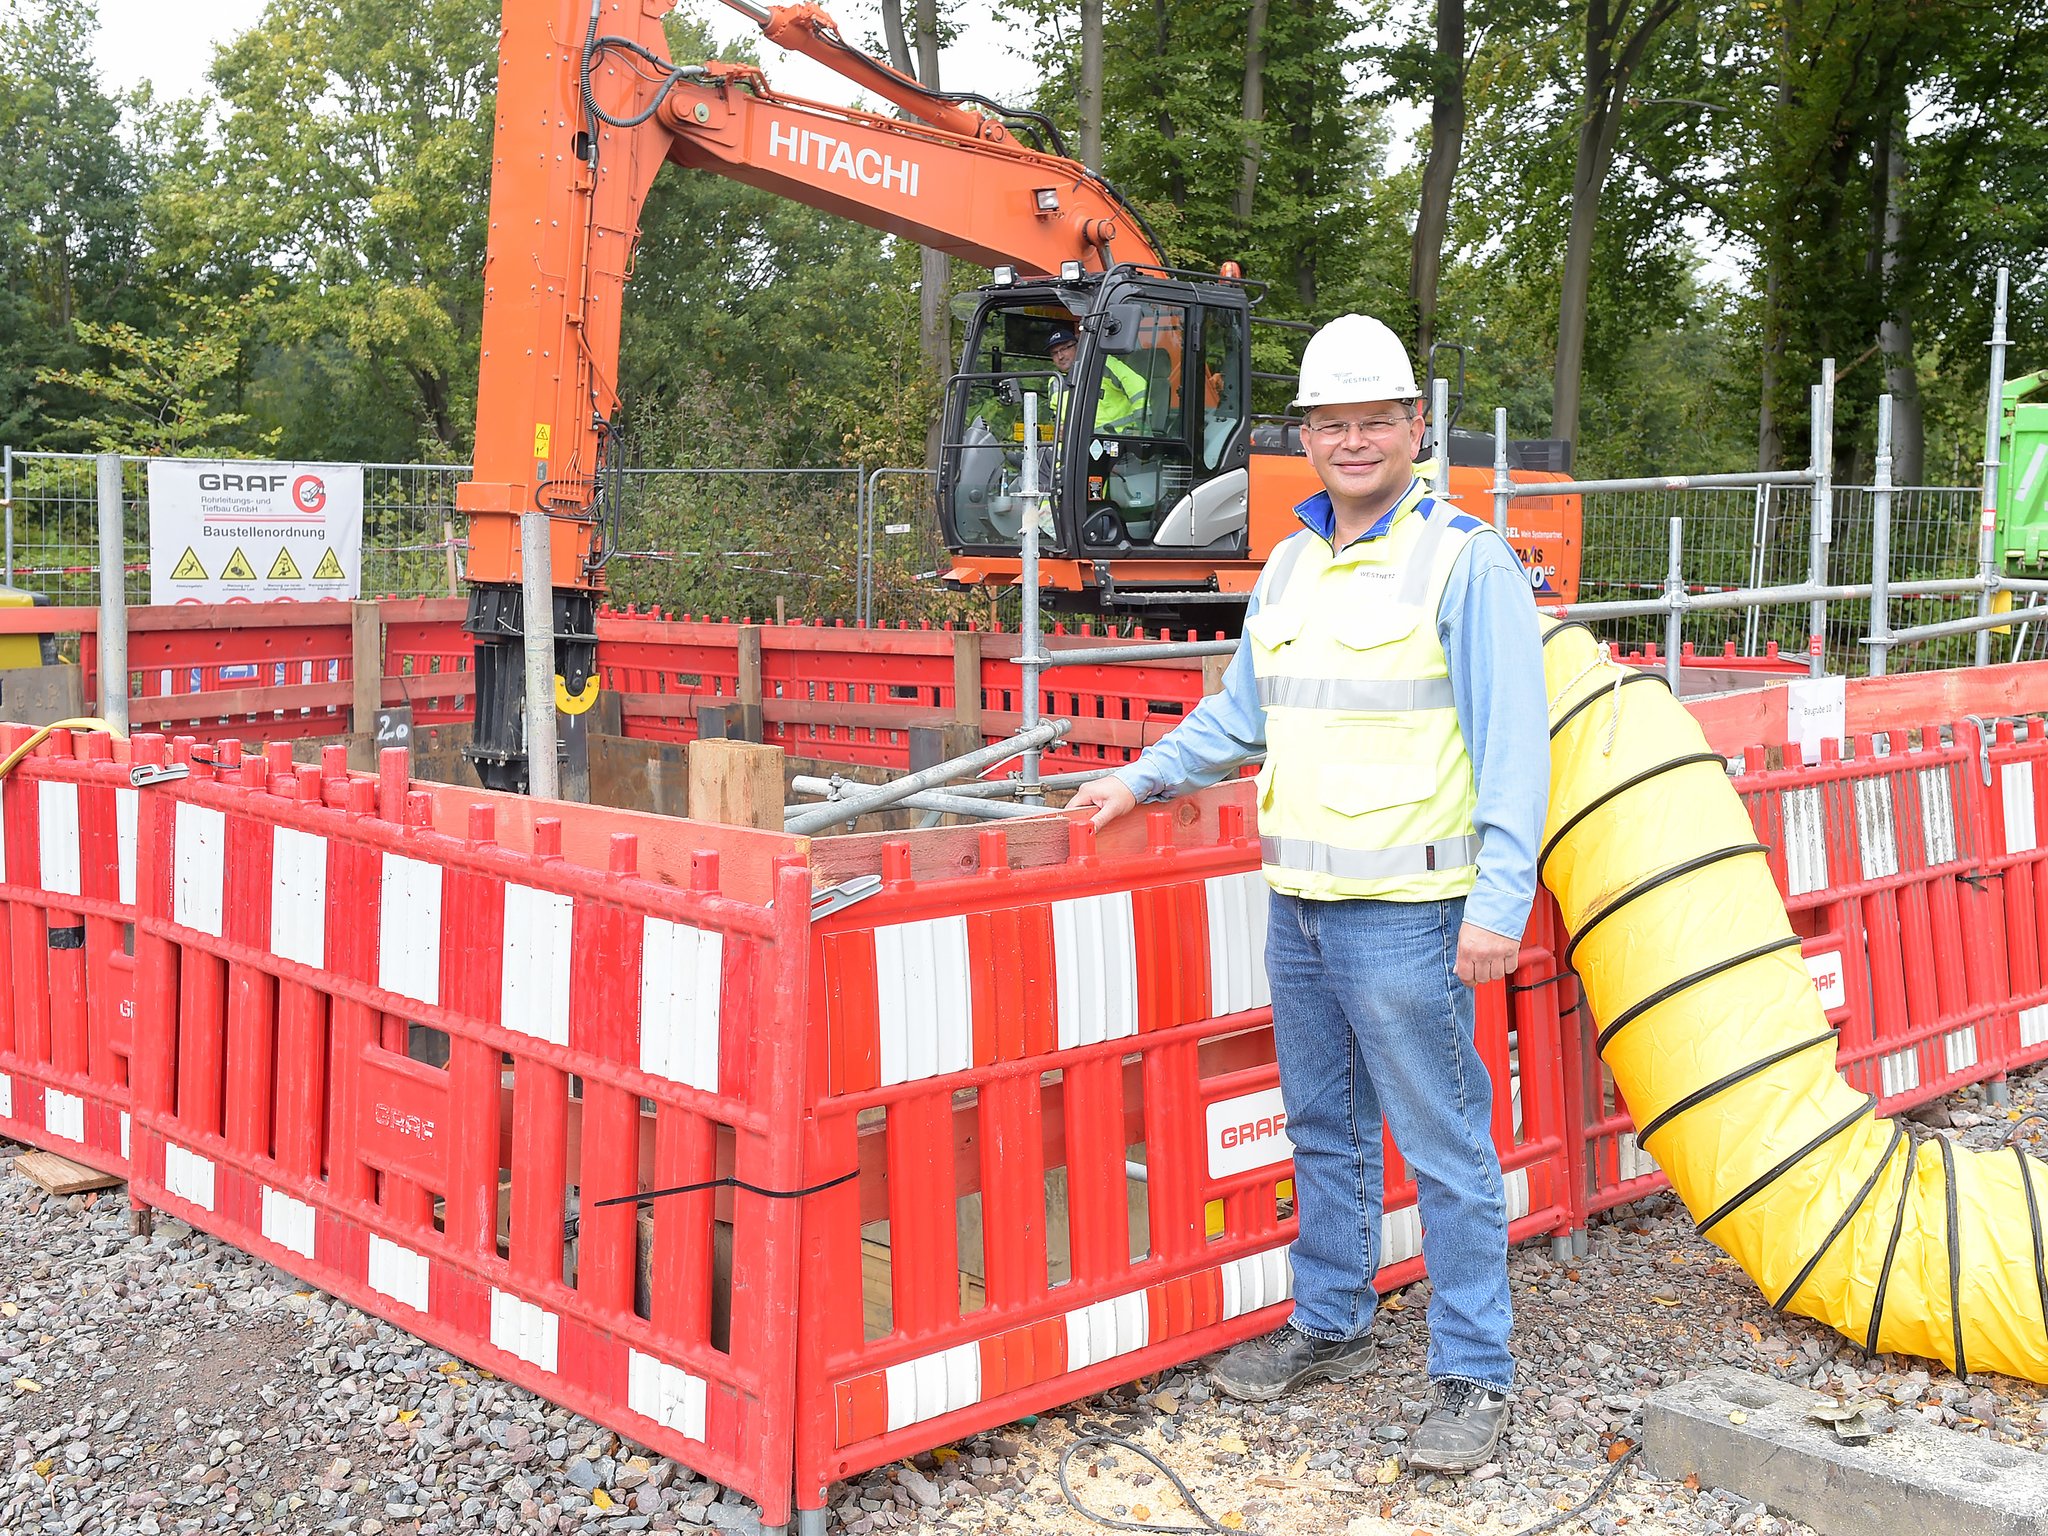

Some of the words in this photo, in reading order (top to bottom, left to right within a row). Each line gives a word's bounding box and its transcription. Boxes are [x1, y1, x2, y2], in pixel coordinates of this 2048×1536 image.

[769, 120, 919, 197] HITACHI
[199, 473, 287, 492] GRAF
[201, 496, 253, 505] Rohrleitungs-
[201, 505, 231, 513] Tiefbau
[233, 505, 258, 513] GmbH
[203, 525, 325, 540] Baustellenordnung
[377, 715, 409, 741] 20
[375, 1103, 434, 1141] GRAF
[1220, 1113, 1286, 1149] GRAF
